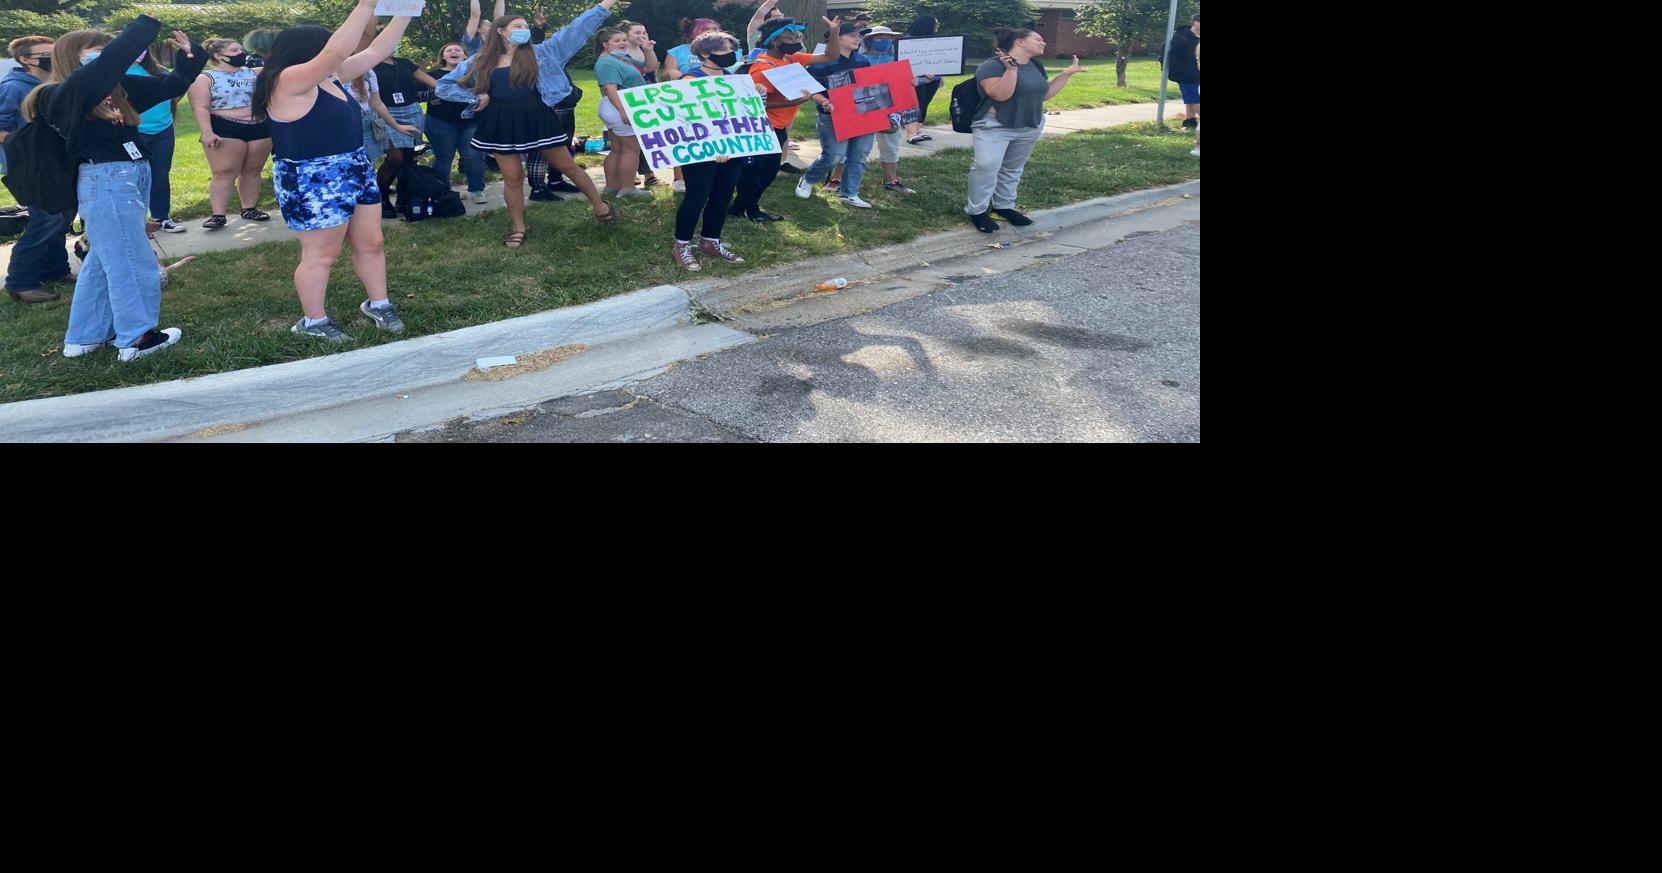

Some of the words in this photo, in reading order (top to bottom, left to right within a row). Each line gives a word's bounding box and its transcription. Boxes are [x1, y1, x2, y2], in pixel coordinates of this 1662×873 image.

[624, 84, 684, 108] LPS
[689, 77, 735, 99] IS
[640, 122, 709, 150] HOLD
[712, 116, 775, 135] THEM
